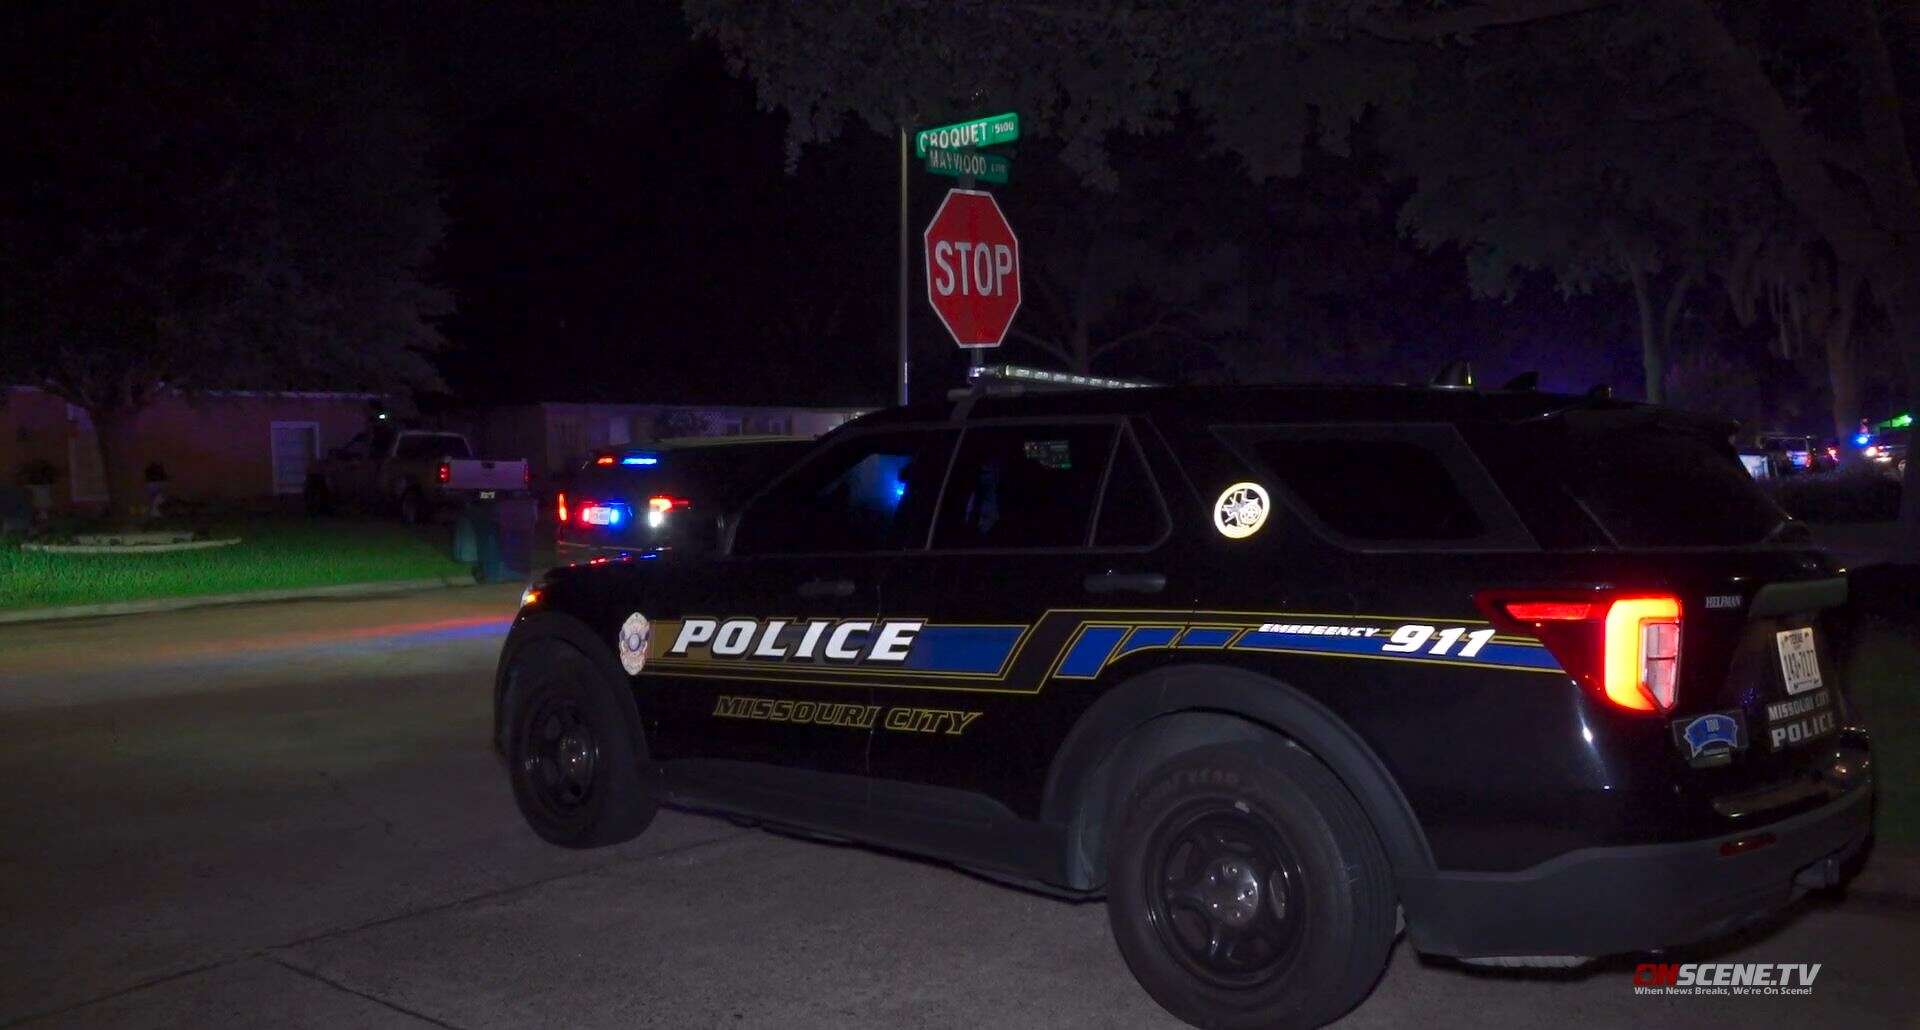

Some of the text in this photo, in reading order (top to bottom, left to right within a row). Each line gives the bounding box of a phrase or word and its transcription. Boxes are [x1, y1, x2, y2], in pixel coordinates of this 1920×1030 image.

[920, 122, 988, 152] CROQUET
[935, 240, 1012, 296] STOP
[670, 618, 924, 661] POLICE
[1258, 623, 1496, 658] EMERGENCY 911
[712, 695, 984, 735] MISSOURI CITY
[1768, 696, 1815, 721] MISSOURI
[1771, 712, 1835, 748] POLICE
